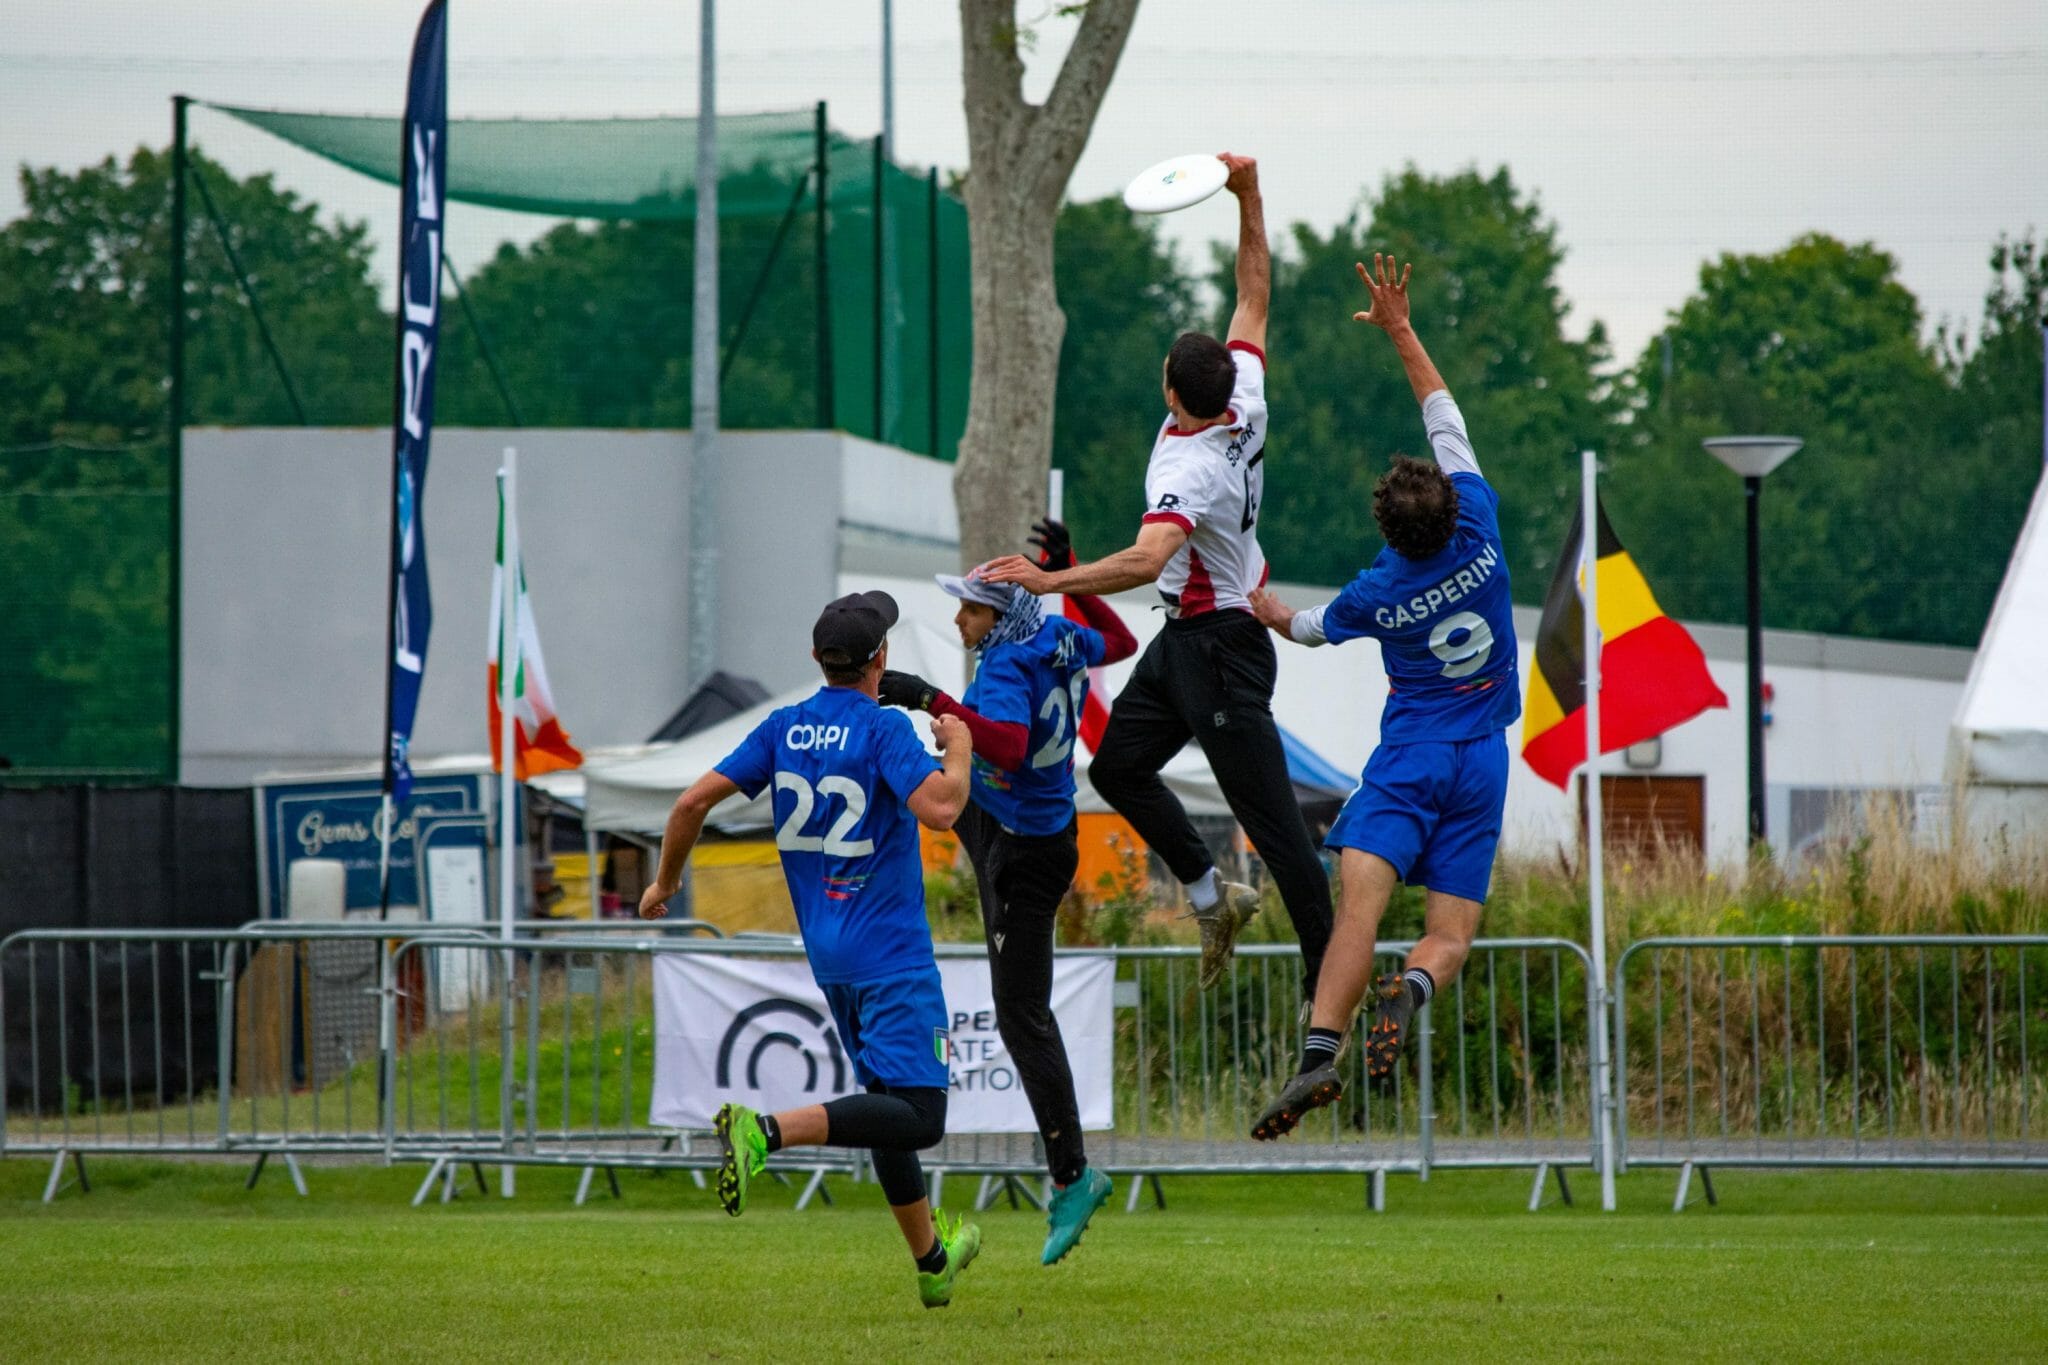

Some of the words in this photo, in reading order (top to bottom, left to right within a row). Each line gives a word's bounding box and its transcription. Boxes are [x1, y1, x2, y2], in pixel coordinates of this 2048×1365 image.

[1375, 542, 1498, 629] GASPERINI
[1428, 611, 1494, 678] 9
[297, 810, 369, 855] Gems
[775, 771, 875, 857] 22
